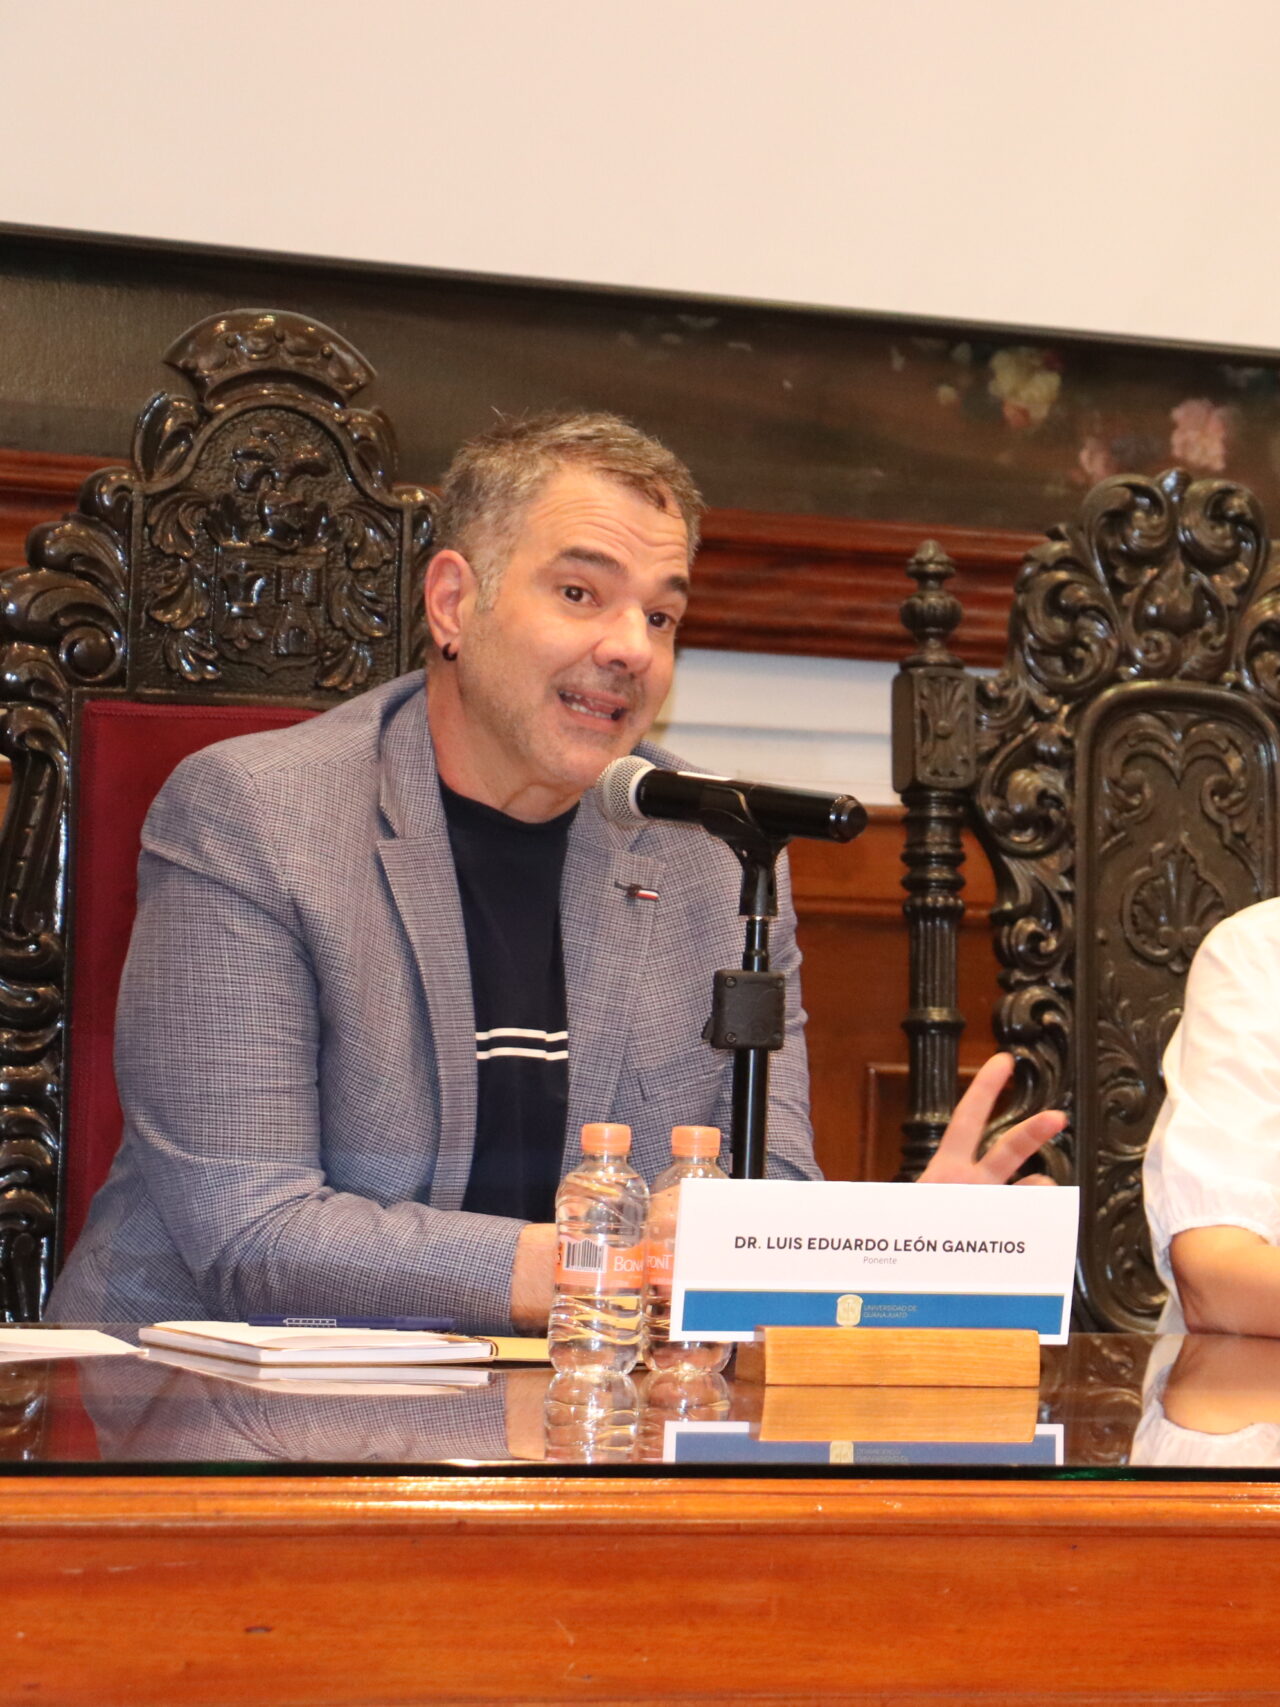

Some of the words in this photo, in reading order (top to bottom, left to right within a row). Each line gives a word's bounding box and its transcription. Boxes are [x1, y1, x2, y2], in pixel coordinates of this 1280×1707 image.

[734, 1235, 761, 1250] DR.
[766, 1236, 803, 1251] LUIS
[807, 1237, 889, 1252] EDUARDO
[893, 1236, 938, 1253] LEÓN
[942, 1239, 1026, 1255] GANATIOS
[863, 1255, 898, 1266] Ponente
